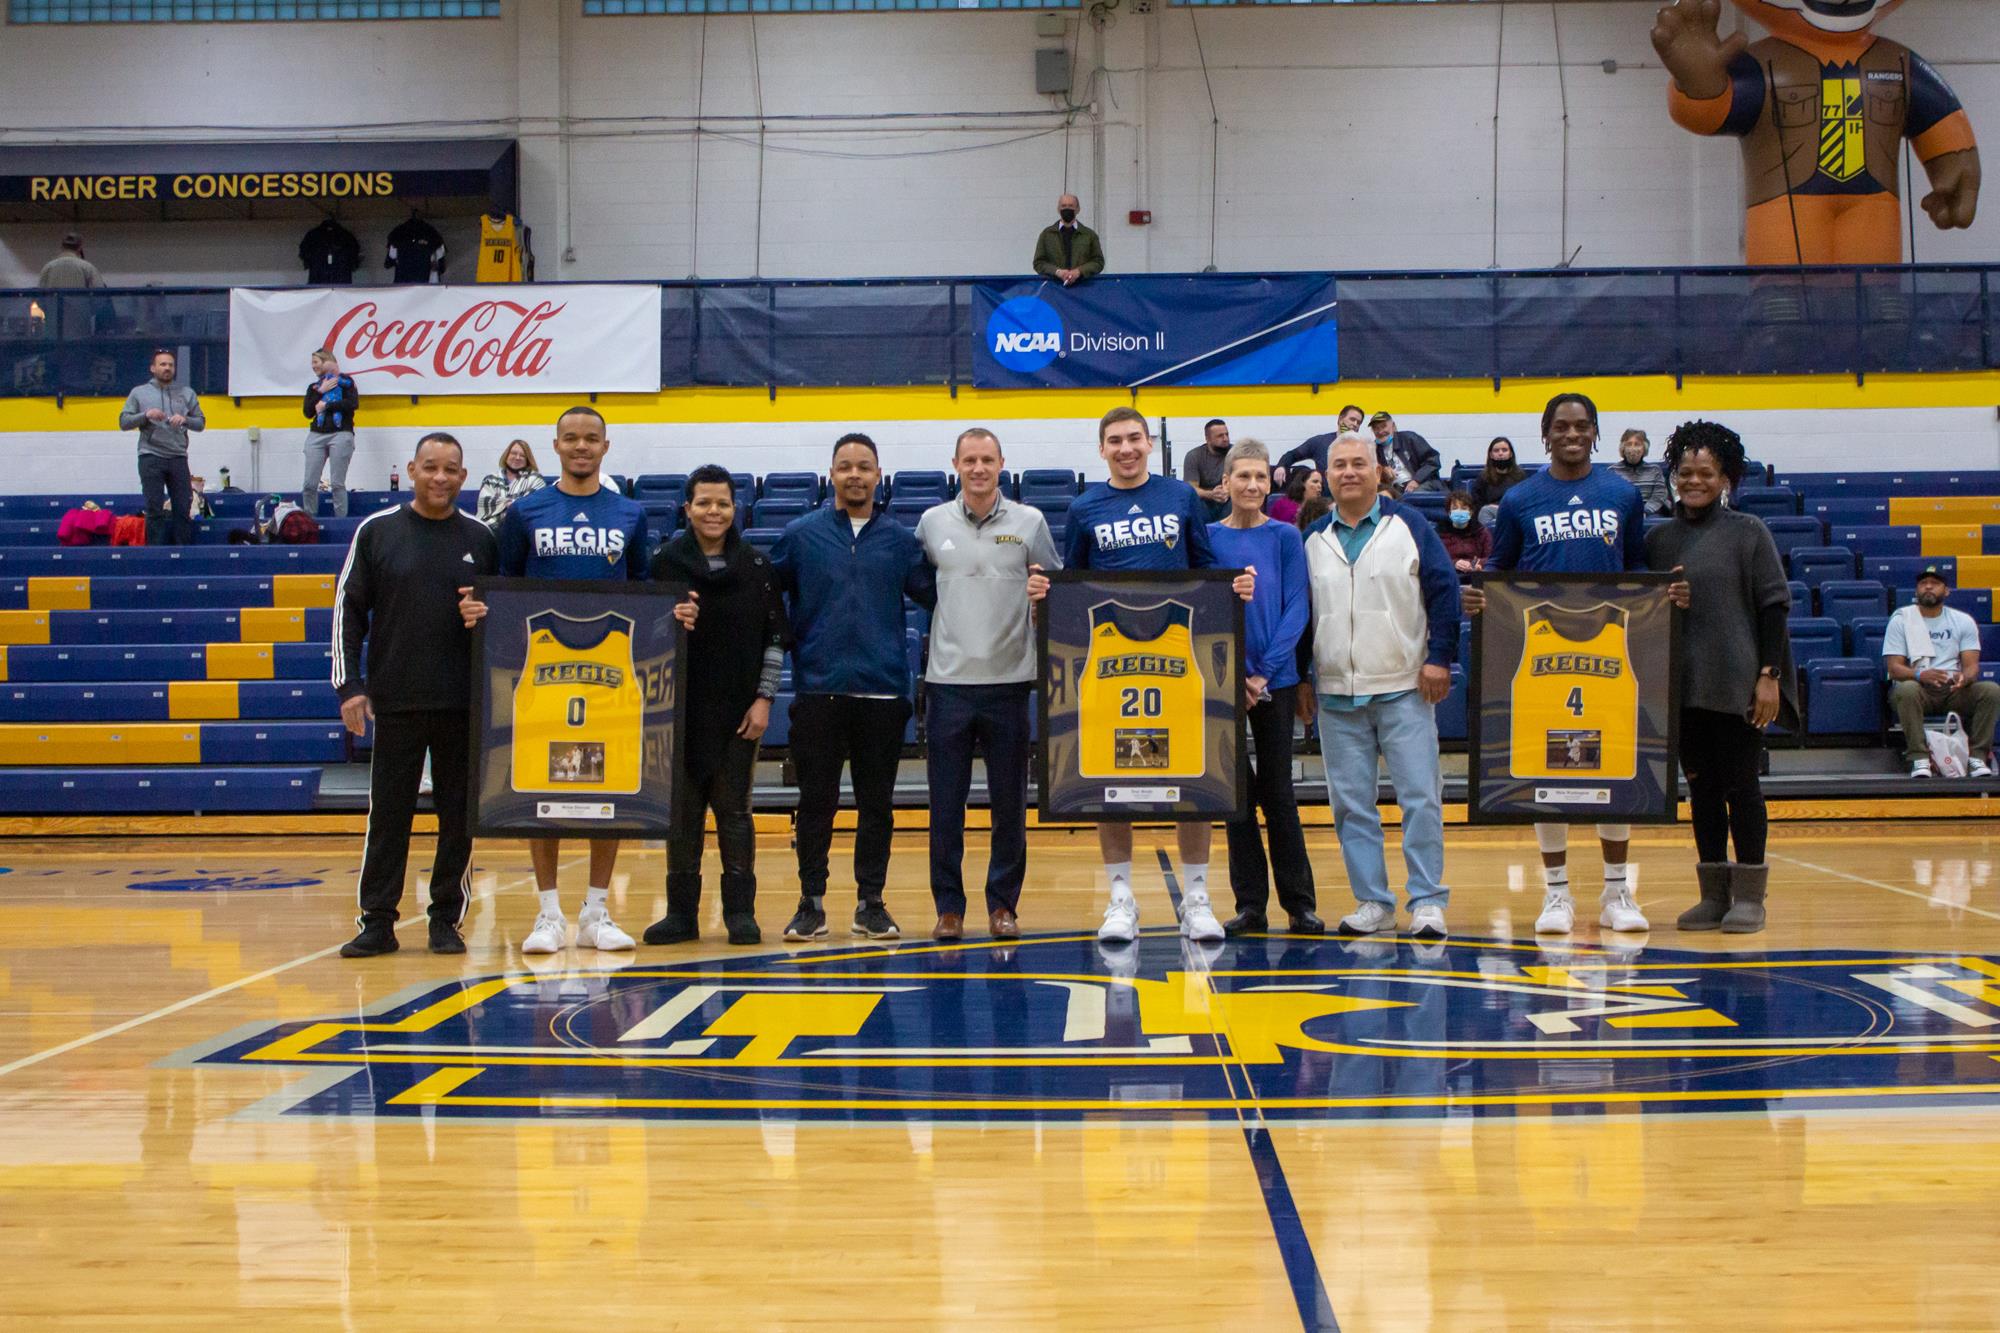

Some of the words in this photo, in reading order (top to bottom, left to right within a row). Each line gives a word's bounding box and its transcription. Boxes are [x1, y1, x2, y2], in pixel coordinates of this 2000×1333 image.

[1867, 72, 1904, 81] RANGERS
[31, 176, 157, 201] RANGER
[173, 172, 394, 198] CONCESSIONS
[322, 300, 568, 378] Coca-Cola
[994, 332, 1061, 353] NCAA
[1070, 332, 1150, 351] Division
[1155, 332, 1165, 350] II
[1094, 513, 1180, 547] REGIS
[1534, 509, 1619, 541] REGIS
[1540, 529, 1603, 544] BASKETBALL
[534, 527, 625, 553] REGIS
[538, 546, 607, 557] BASKETBALL
[1100, 533, 1166, 551] BASKETBALL
[533, 661, 624, 688] REGIS
[1097, 653, 1188, 679] REGIS
[1530, 652, 1623, 679] REGIS
[566, 696, 587, 728] 0
[1120, 686, 1163, 718] 20
[1564, 685, 1584, 717] 4
